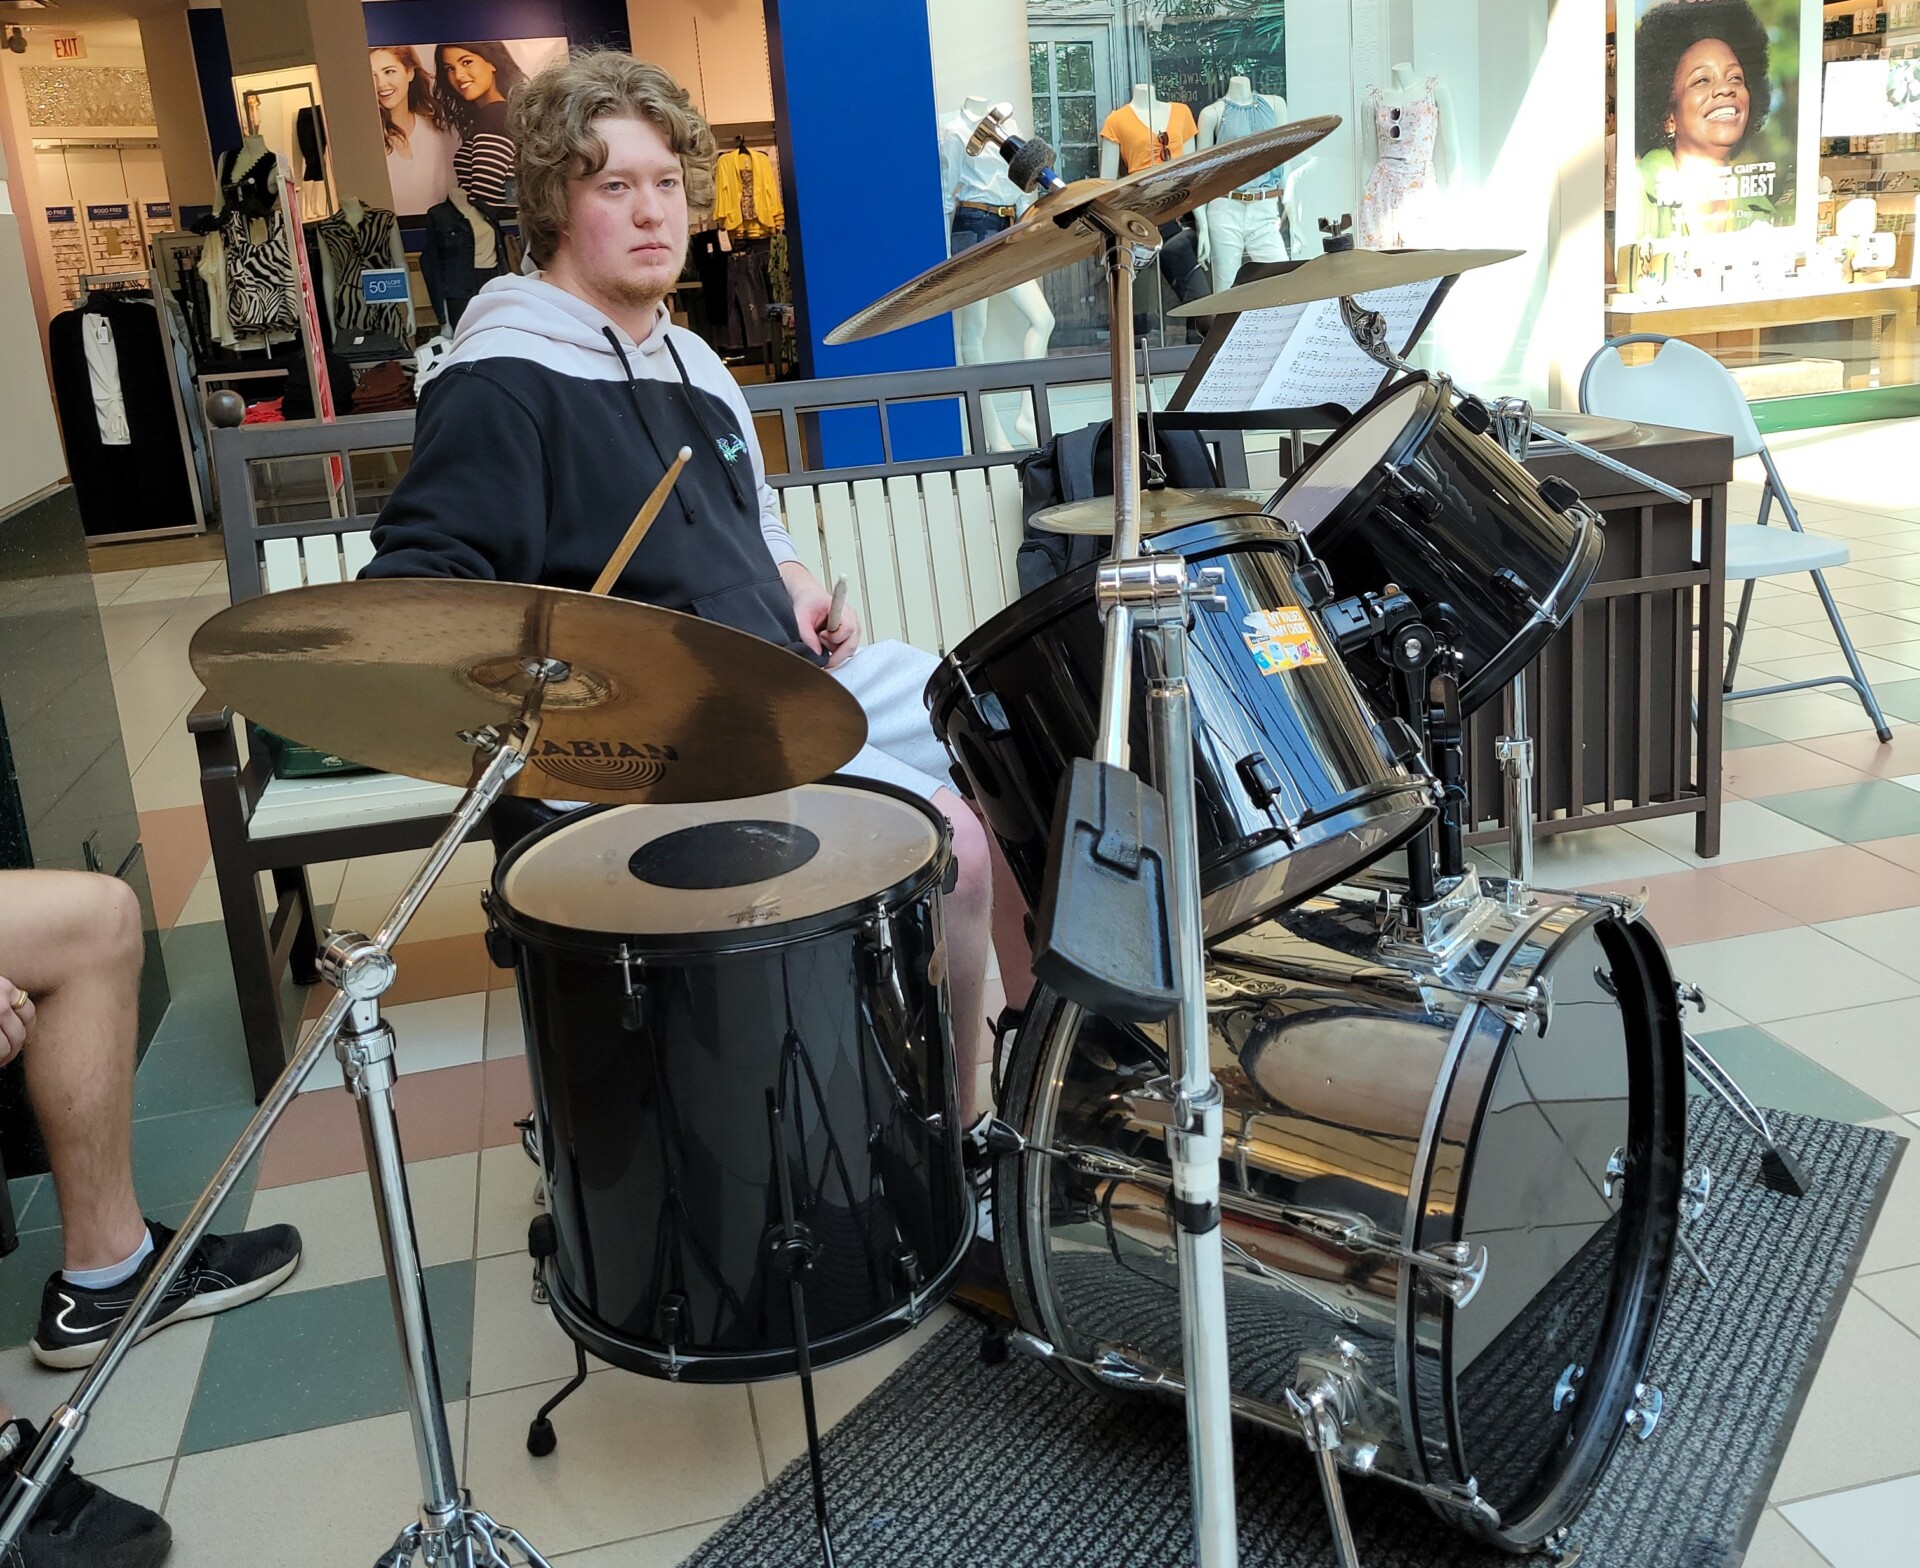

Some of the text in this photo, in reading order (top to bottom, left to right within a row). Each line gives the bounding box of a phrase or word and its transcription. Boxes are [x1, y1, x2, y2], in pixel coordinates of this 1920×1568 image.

[54, 38, 78, 57] EXIT
[1734, 161, 1776, 174] GIFTS
[1740, 173, 1776, 199] BEST
[1736, 210, 1753, 218] Day
